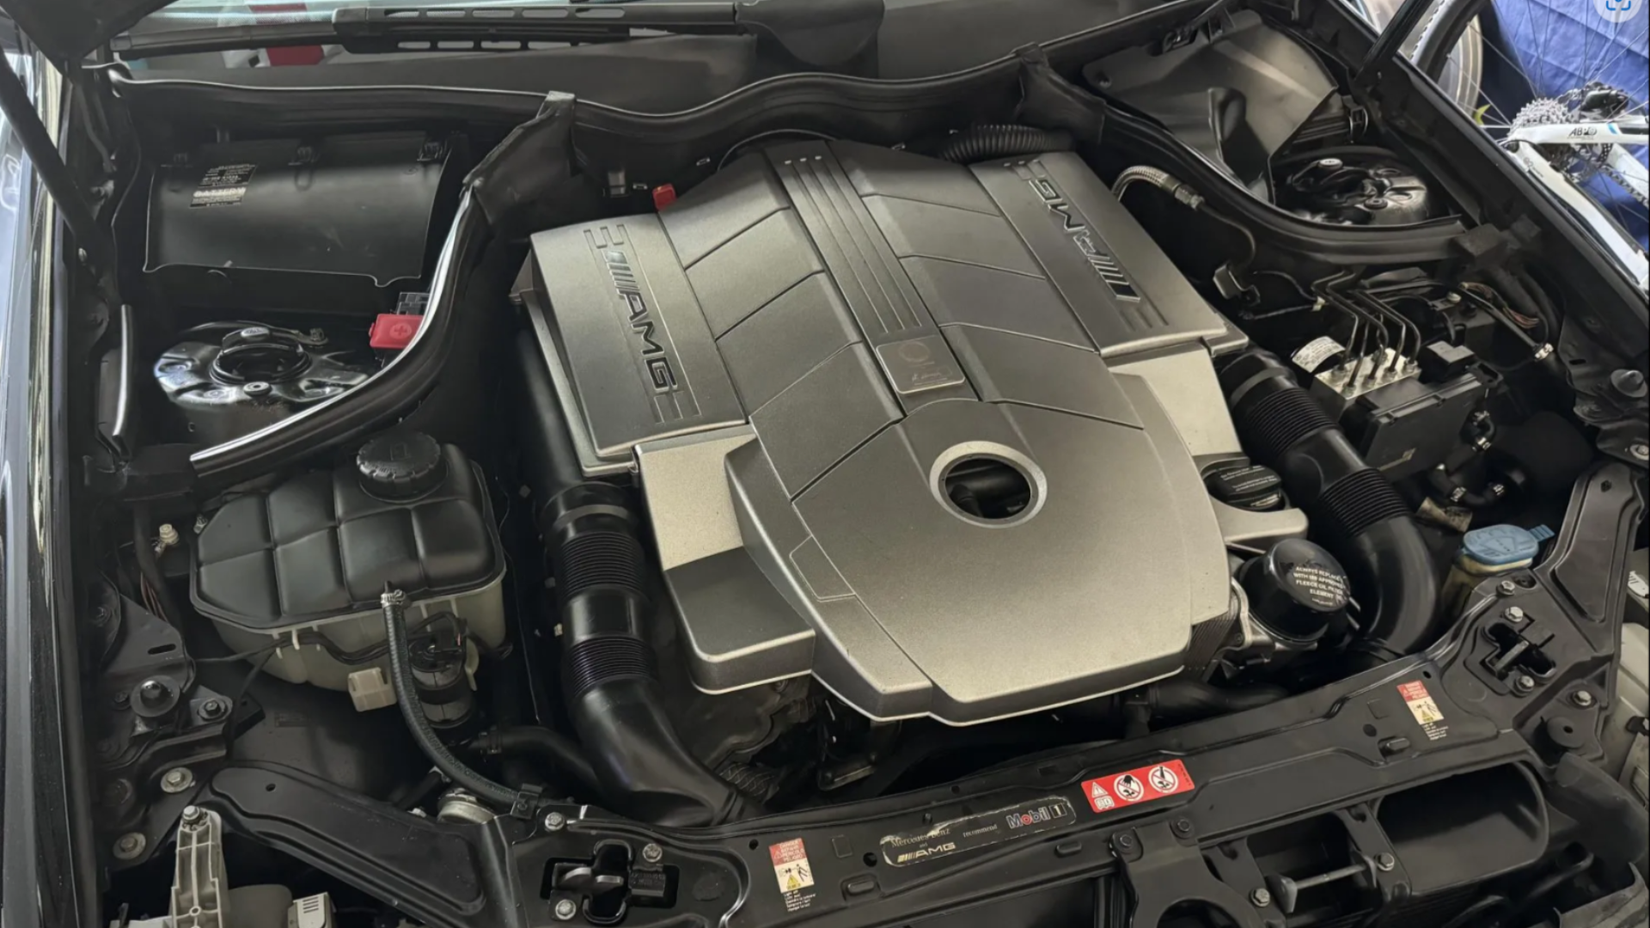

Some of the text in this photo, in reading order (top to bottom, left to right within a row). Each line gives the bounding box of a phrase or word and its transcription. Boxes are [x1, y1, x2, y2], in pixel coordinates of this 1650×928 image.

[1029, 179, 1112, 264] AMG
[616, 286, 678, 393] AMG
[1295, 566, 1318, 574] ALWAYS
[1309, 588, 1334, 598] ELEMENT
[1006, 808, 1050, 829] Mobil
[962, 824, 998, 838] recommend
[913, 842, 956, 859] AMG
